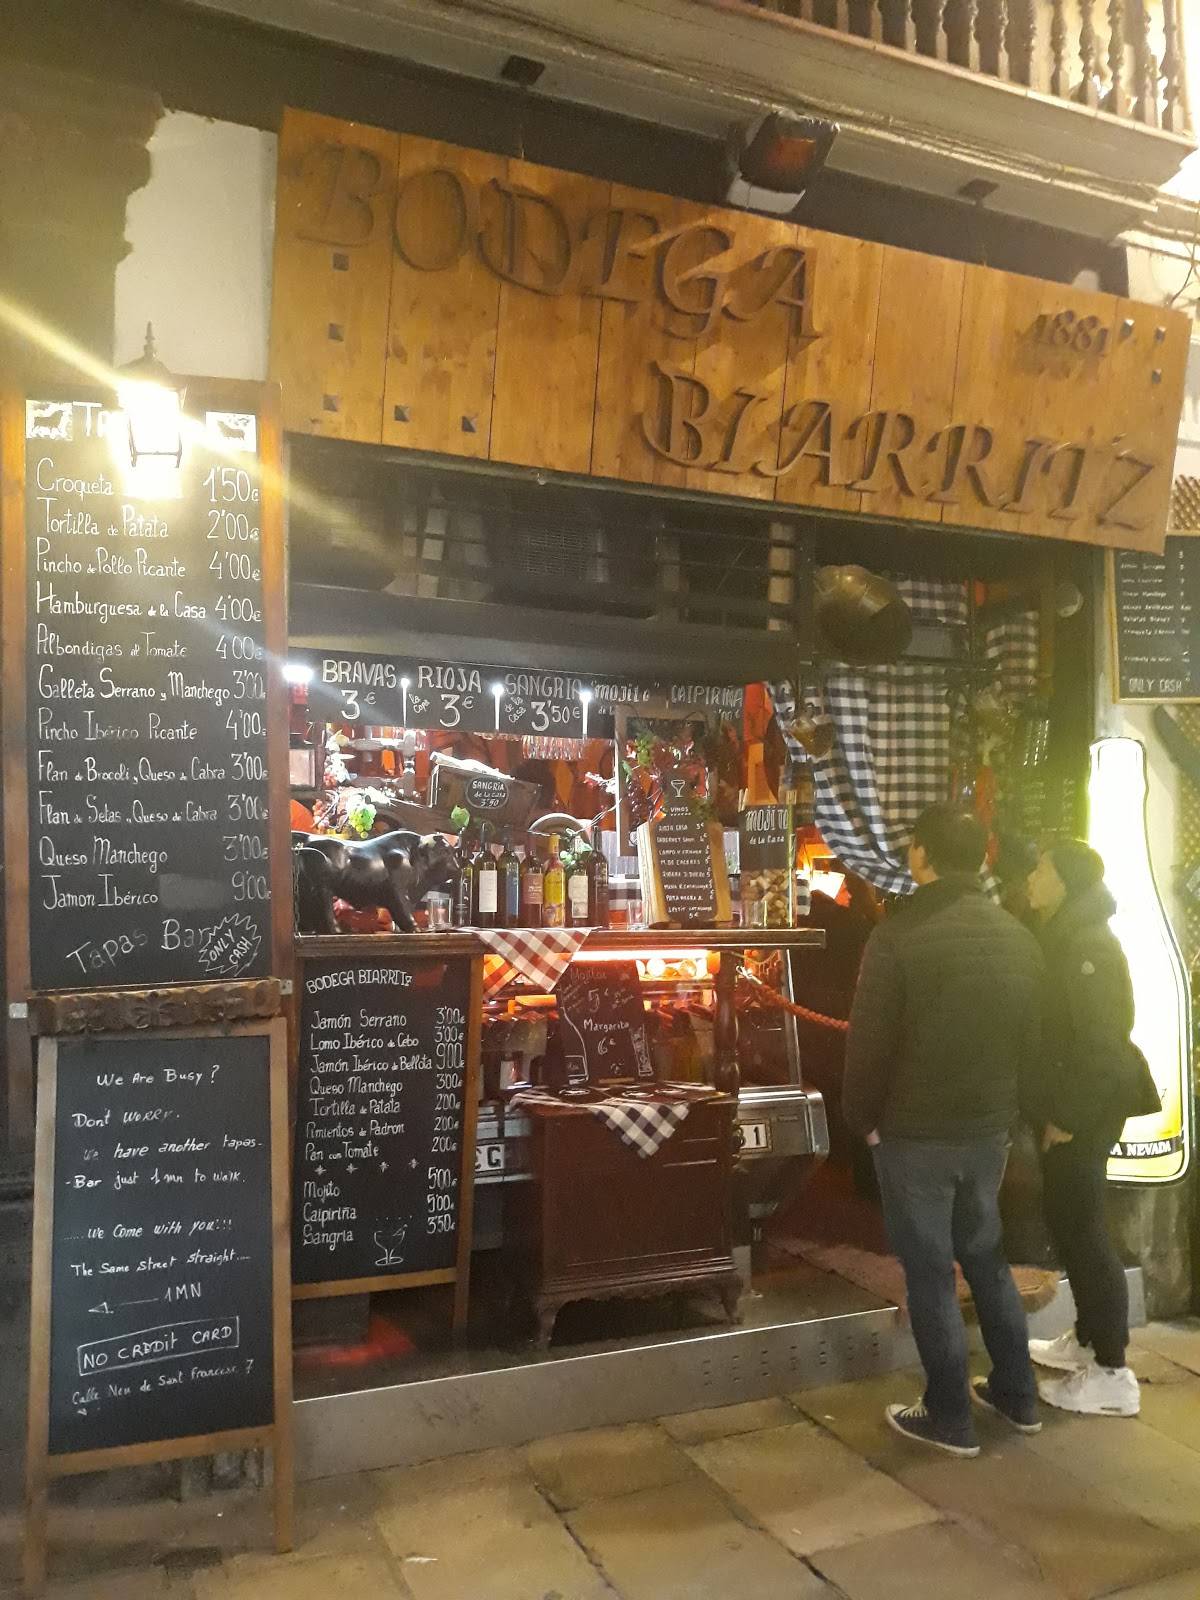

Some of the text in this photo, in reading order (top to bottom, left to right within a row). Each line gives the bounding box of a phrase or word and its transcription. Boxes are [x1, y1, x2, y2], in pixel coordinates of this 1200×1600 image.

[293, 140, 822, 342] BODEGA
[636, 358, 1156, 532] BIARRITZ
[37, 458, 114, 501] Croqueta
[37, 497, 99, 535] Tortilla
[122, 505, 168, 537] Patata
[37, 537, 82, 573] Pincho
[96, 547, 132, 574] Pollo
[136, 548, 186, 577] Picante
[36, 581, 142, 623] Hamburguesa
[175, 591, 206, 618] Casa
[36, 623, 122, 663] Albondigas
[140, 631, 187, 658] Tomate
[39, 664, 95, 699] Galleta
[100, 668, 155, 698] Serrano
[168, 671, 230, 706] Manchego
[322, 659, 398, 689] BRAVAS
[418, 665, 481, 693] RIOJA
[38, 707, 78, 740] Pincho
[149, 713, 198, 740] Picante
[38, 750, 68, 781] Flan
[139, 757, 175, 781] Queso
[191, 757, 225, 780] Cabra
[38, 791, 70, 824] Flan
[86, 794, 121, 823] Setas
[133, 800, 168, 823] Queso
[186, 801, 218, 822] Cabra
[40, 836, 87, 866] Queso
[93, 836, 167, 873] Manchego
[41, 875, 95, 909] Jamon
[65, 919, 211, 973] Tapas Bar
[210, 928, 235, 961] ONLY
[229, 936, 252, 965] CASH
[306, 969, 412, 993] BODEGA BIARRITZ
[311, 1010, 351, 1030] Jamón
[360, 1009, 406, 1027] Serrano
[310, 1033, 340, 1050] Lomo
[342, 1033, 383, 1049] Ibérico
[397, 1032, 419, 1047] Cebo
[97, 1073, 124, 1086] We
[132, 1073, 154, 1084] Are
[163, 1068, 202, 1085] Busy
[310, 1054, 349, 1073] Jamón
[352, 1054, 388, 1072] Ibérico
[399, 1055, 432, 1071] Bellota
[309, 1076, 344, 1095] Queso
[348, 1076, 403, 1097] Manchego
[309, 1098, 355, 1116] Tortilla
[369, 1098, 400, 1113] Patata
[306, 1121, 354, 1138] Pimientos
[114, 1143, 149, 1159] have
[158, 1138, 210, 1153] another
[305, 1142, 323, 1161] Pan
[342, 1140, 379, 1158] Tomate
[1126, 1141, 1172, 1156] NEVADA
[114, 1171, 139, 1189] just
[194, 1168, 206, 1182] to
[304, 1181, 340, 1203] Mojito
[154, 1221, 182, 1235] with
[70, 1263, 93, 1276] The
[83, 1326, 232, 1369] NO CARD
[71, 1392, 99, 1405] Calle
[140, 1380, 152, 1392] de
[158, 1371, 183, 1386] Sant
